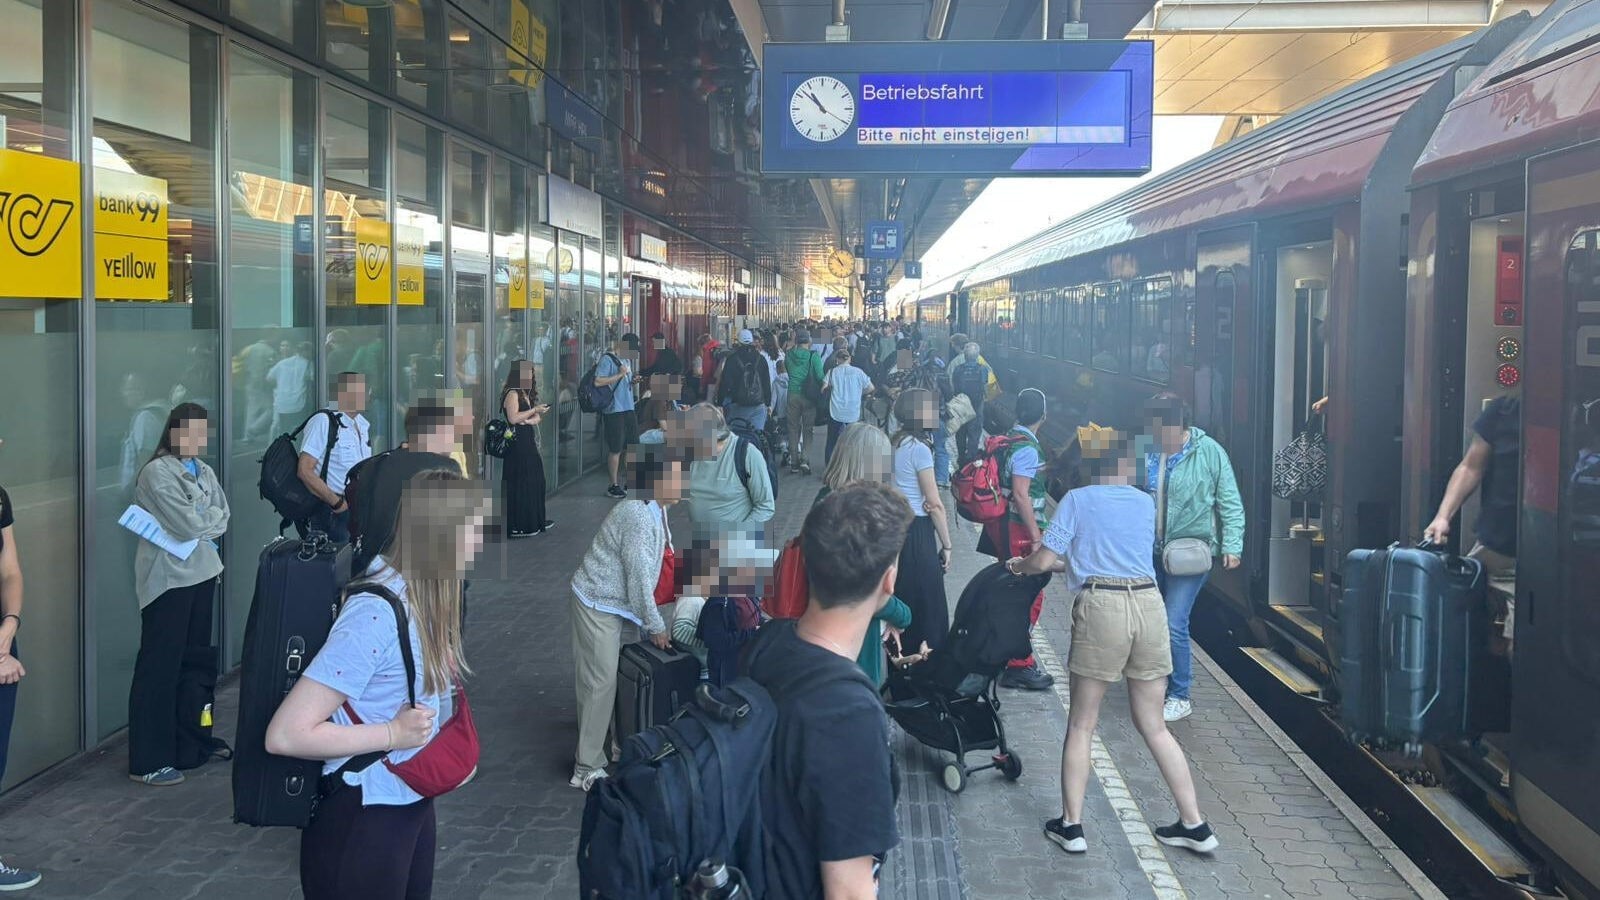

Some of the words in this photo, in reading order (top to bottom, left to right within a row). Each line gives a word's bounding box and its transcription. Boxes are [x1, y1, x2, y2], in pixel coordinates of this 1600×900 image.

[863, 84, 984, 100] Betriebsfahrt
[858, 129, 893, 141] Bitte
[899, 129, 936, 141] nicht
[943, 128, 1029, 143] einsteigen!
[1506, 259, 1515, 269] 2
